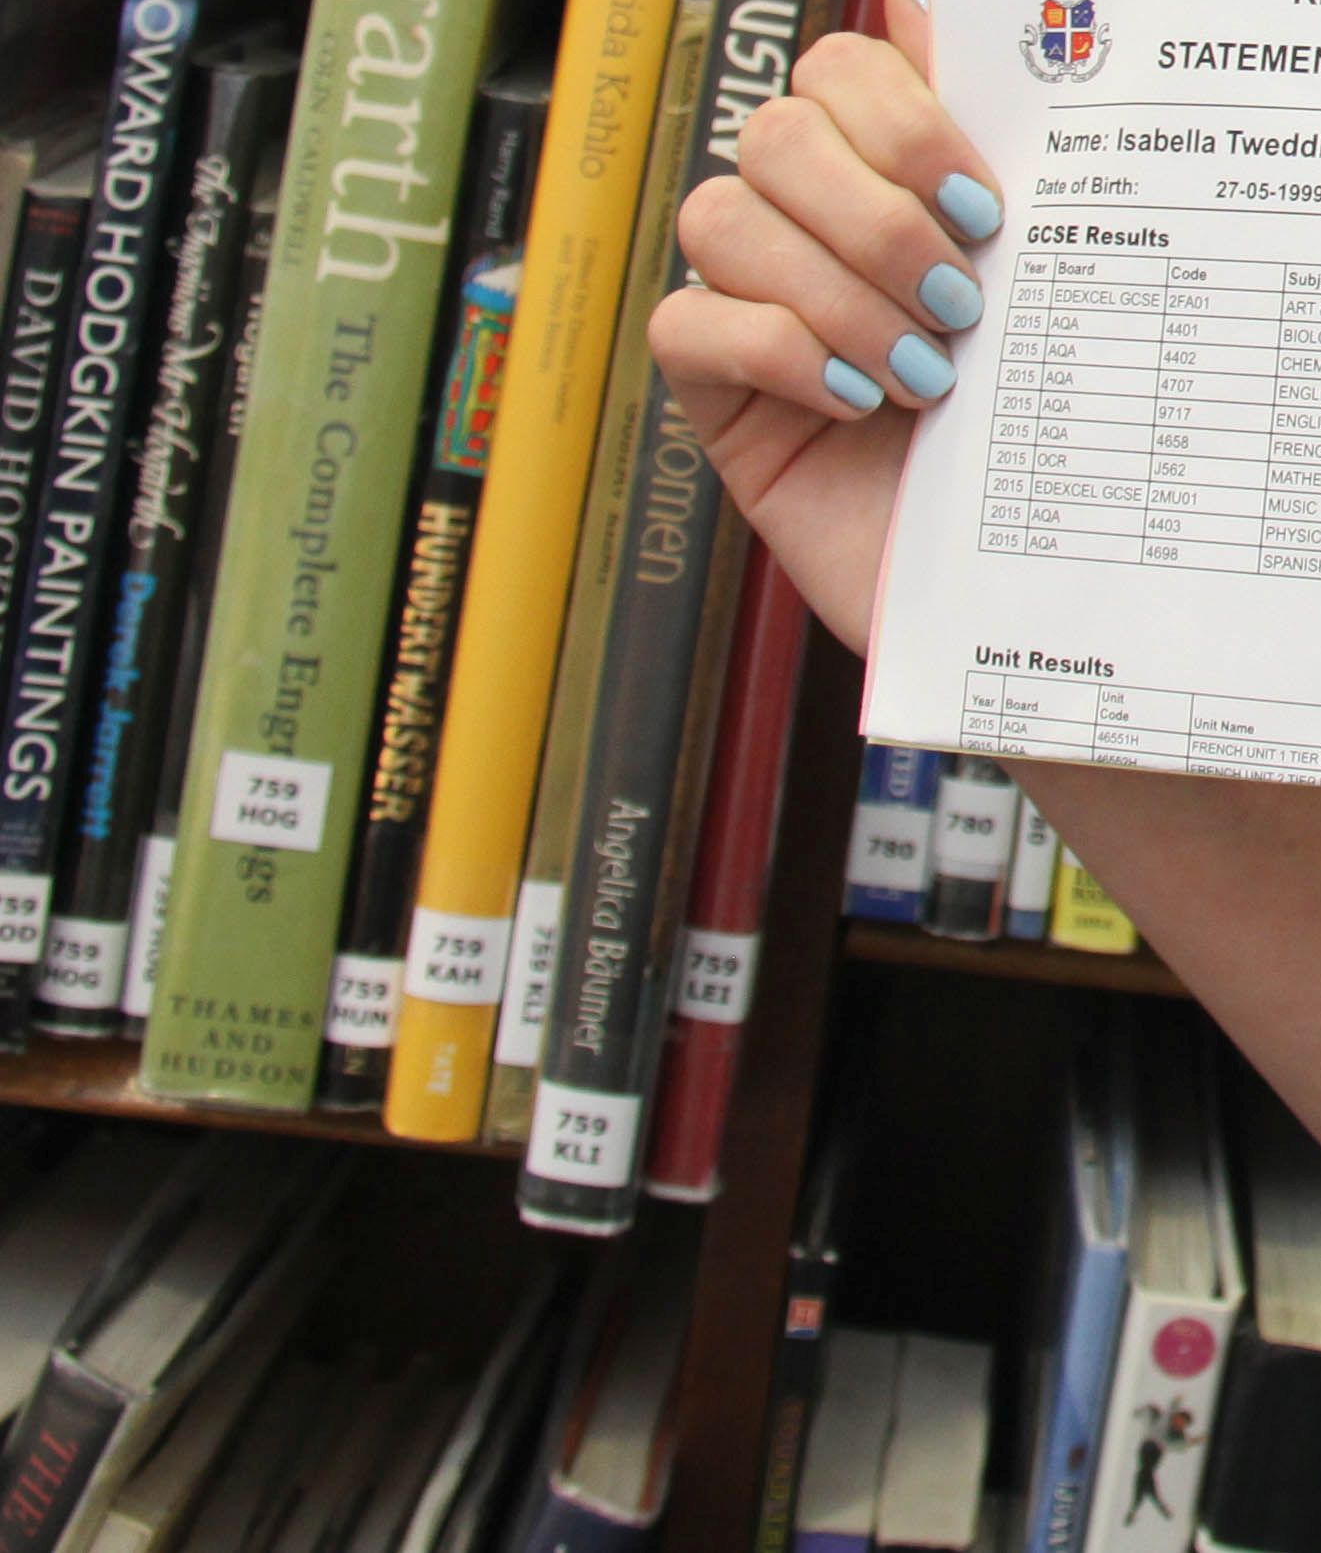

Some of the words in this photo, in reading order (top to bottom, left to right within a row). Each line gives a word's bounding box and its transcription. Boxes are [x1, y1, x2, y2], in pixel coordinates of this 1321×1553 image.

[579, 69, 631, 182] Kahlo
[1047, 131, 1108, 155] Name:
[1117, 127, 1216, 156] Isabella
[1036, 178, 1065, 195] Date
[1071, 178, 1087, 195] of
[1092, 178, 1138, 196] Birth:
[1028, 226, 1077, 244] GCSE
[1086, 229, 1169, 247] Results
[1023, 262, 1047, 274] Year
[1058, 262, 1095, 275] Board
[1172, 267, 1207, 281] Code
[1016, 288, 1045, 302] 2015
[1055, 289, 1115, 305] EDEXCEL
[1120, 292, 1160, 307] GCSE
[1169, 295, 1209, 310] 2FA01
[1286, 302, 1316, 315] ART
[1051, 317, 1079, 331] AQA
[1166, 323, 1198, 337] 4401
[2, 269, 63, 432] DAVID
[54, 225, 143, 492] HODGKIN
[324, 314, 376, 403] The
[1048, 344, 1076, 358] AQA
[1163, 351, 1196, 364] 4402
[1161, 378, 1193, 392] 4707
[1159, 406, 1191, 420] 9717
[1040, 426, 1068, 440] AQA
[1157, 434, 1188, 448] 4658
[1037, 453, 1066, 468] OCR
[1154, 462, 1185, 476] J562
[1034, 481, 1097, 498] EDEXCEL
[1103, 486, 1142, 501] GCSE
[1151, 490, 1197, 504] 2MU01
[1268, 499, 1317, 515] MUSIC
[287, 419, 359, 637] Complete
[1148, 518, 1181, 532] 4403
[1146, 546, 1178, 560] 4698
[4, 511, 95, 802] PAINTINGS
[370, 501, 469, 822] HUNDERTWASSER
[976, 646, 1020, 668] Unit
[1029, 651, 1114, 677] Results
[1192, 742, 1242, 757] FRENCH
[1246, 747, 1276, 761] UNIT
[1290, 750, 1318, 764] TIER
[249, 778, 300, 800] 759
[239, 805, 298, 831] HOG
[594, 797, 650, 930] Angelica
[434, 935, 482, 958] 759
[426, 963, 481, 986] KAH
[688, 954, 739, 977] 759
[339, 978, 388, 1002] 759
[574, 936, 627, 1056] Bäumer
[687, 980, 731, 1005] LEI
[171, 995, 316, 1029] THAMES
[333, 1006, 388, 1029] HUN
[202, 1030, 274, 1053] AND
[160, 1052, 308, 1086] HUDSON
[556, 1111, 609, 1136] 759
[553, 1140, 603, 1166] KLI
[3, 1429, 78, 1537] THE
